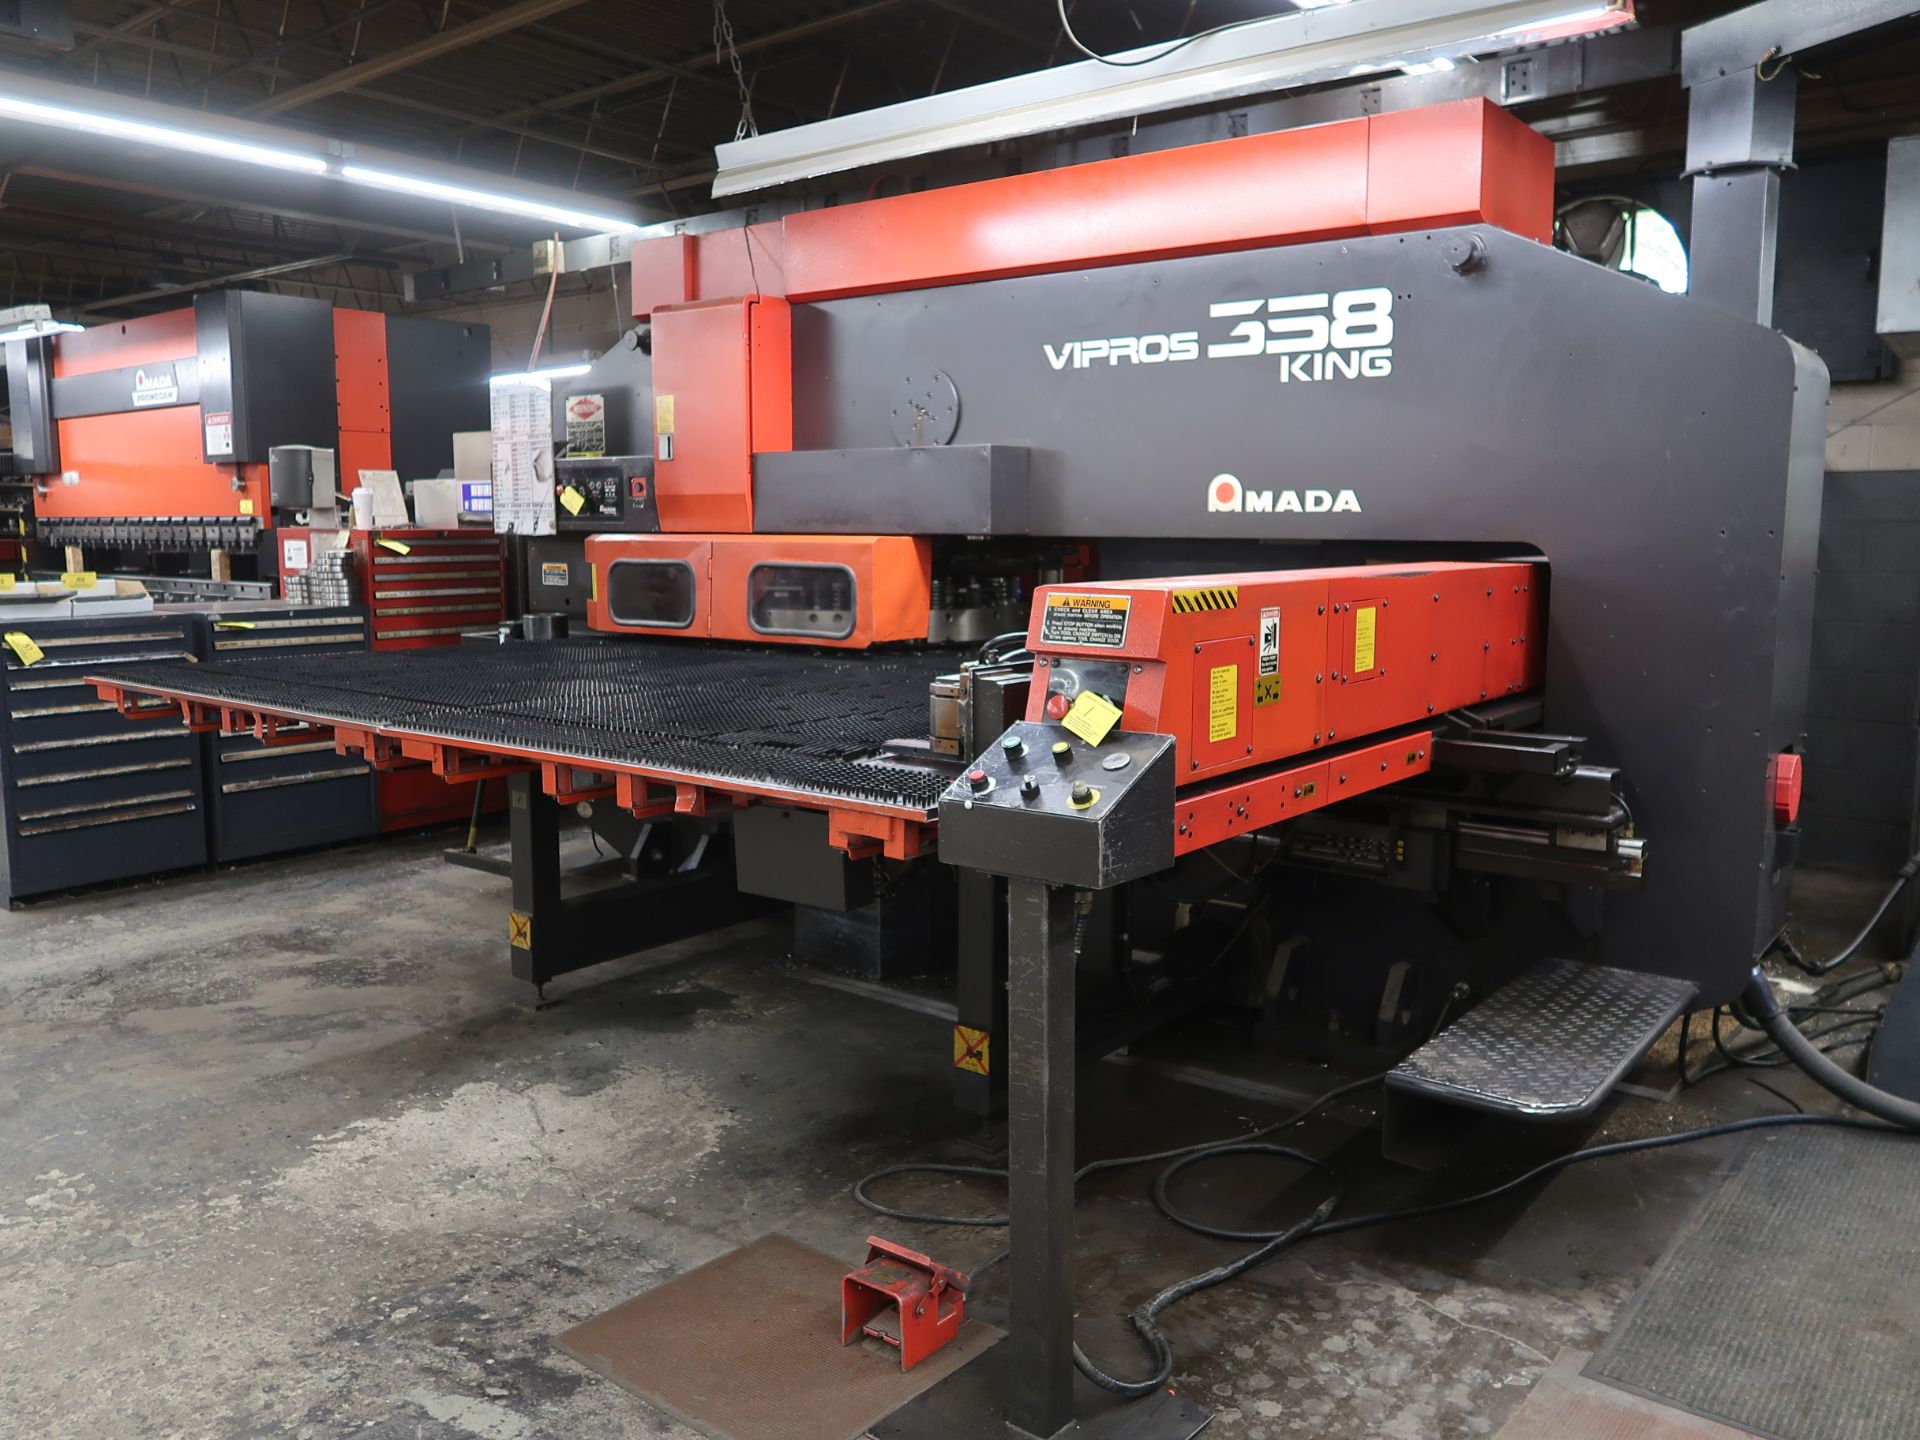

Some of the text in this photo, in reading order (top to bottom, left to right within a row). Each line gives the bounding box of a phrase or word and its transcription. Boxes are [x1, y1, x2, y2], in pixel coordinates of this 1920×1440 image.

[1043, 287, 1394, 370] VIPROS 358
[1279, 348, 1393, 383] KING
[1207, 473, 1362, 513] AMADA
[1073, 599, 1111, 608] WARNING
